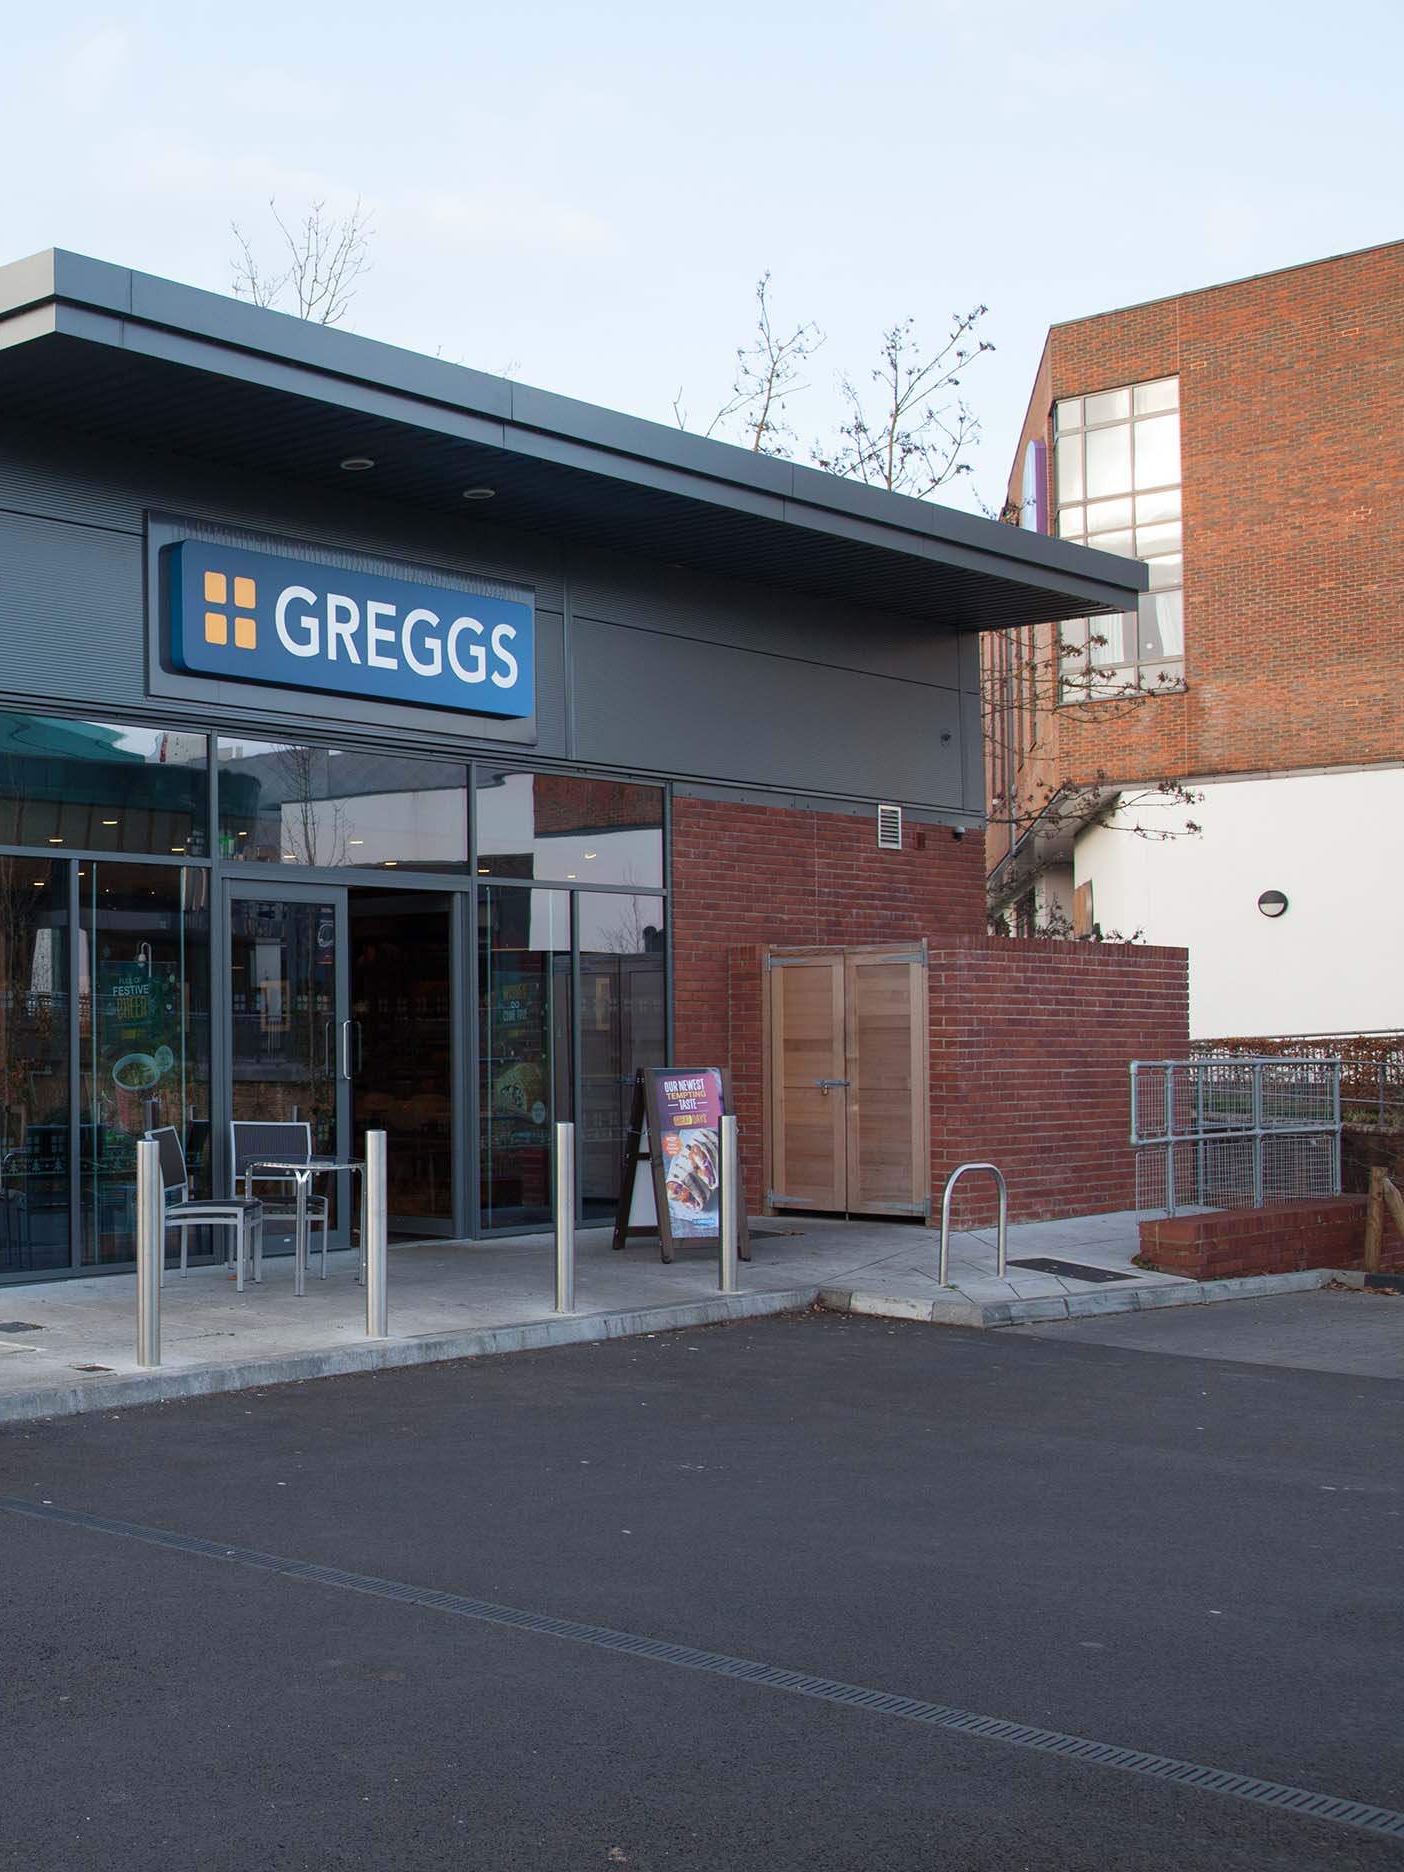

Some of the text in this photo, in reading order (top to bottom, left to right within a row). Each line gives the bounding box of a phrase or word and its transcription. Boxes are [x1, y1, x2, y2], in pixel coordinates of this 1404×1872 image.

[275, 585, 519, 689] GREGGS
[112, 984, 148, 997] FESTIVE
[664, 1078, 705, 1093] OUR NEWEST
[666, 1090, 707, 1100] TEMPTING
[679, 1099, 698, 1110] TASTE
